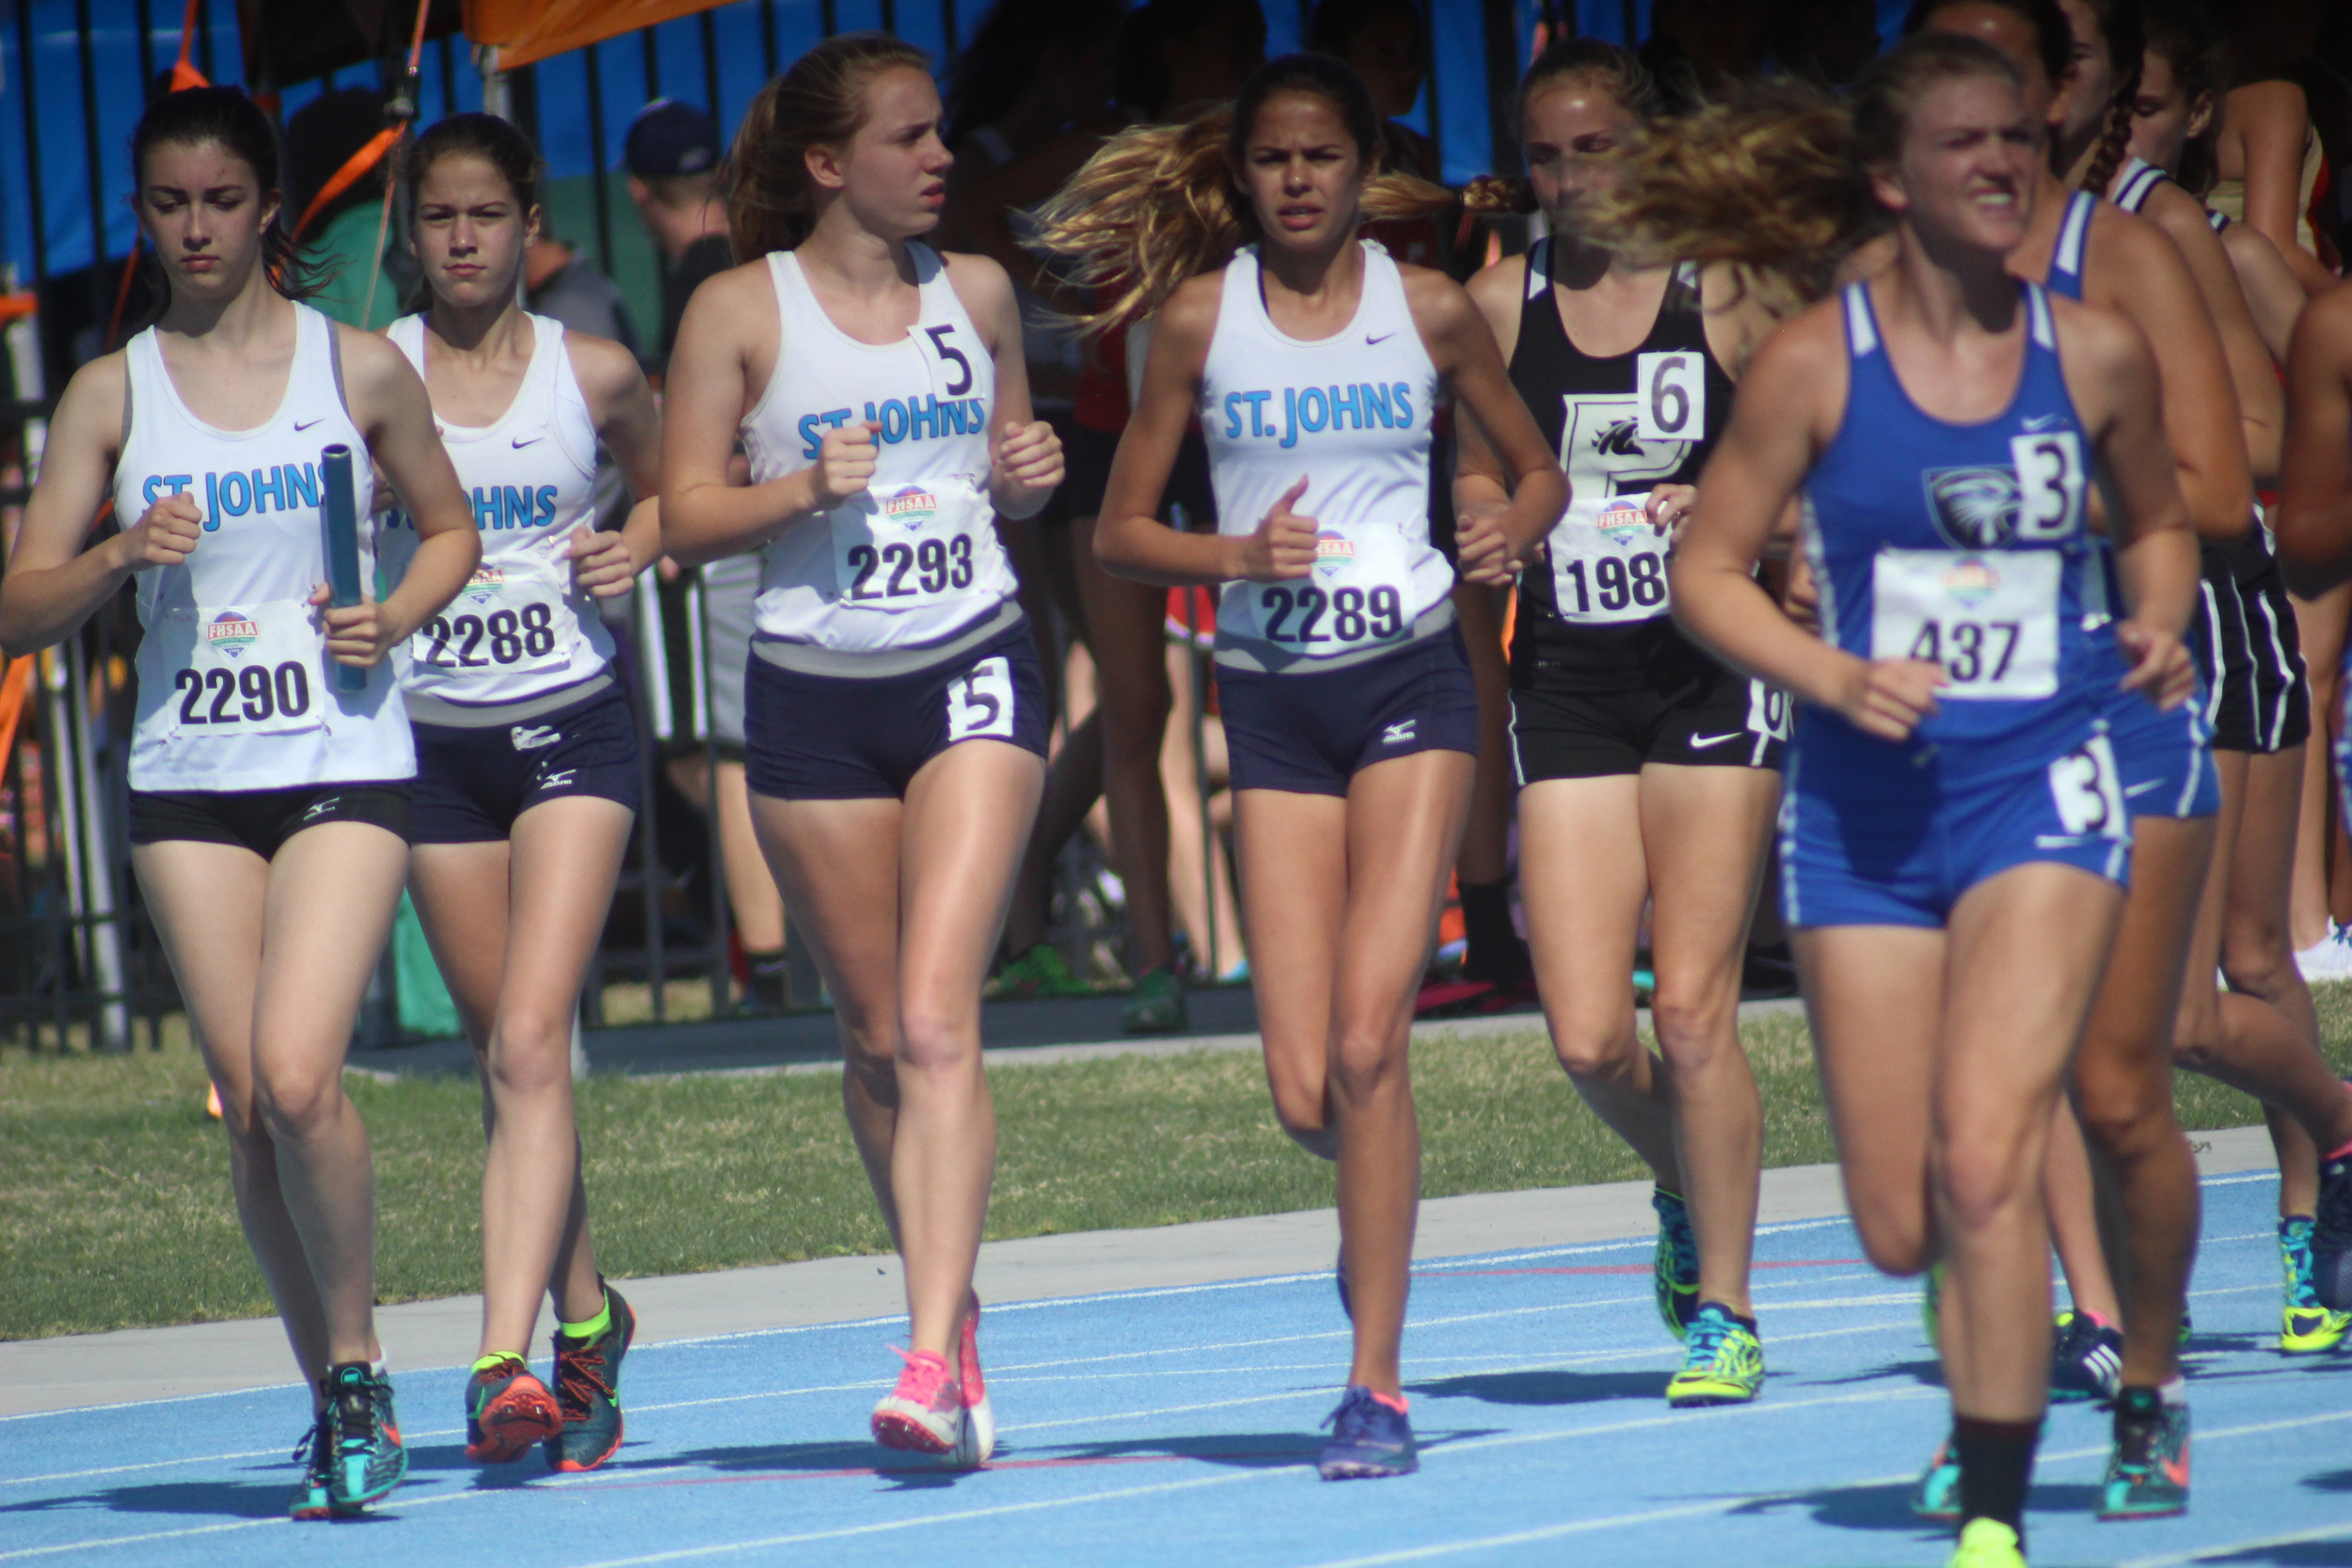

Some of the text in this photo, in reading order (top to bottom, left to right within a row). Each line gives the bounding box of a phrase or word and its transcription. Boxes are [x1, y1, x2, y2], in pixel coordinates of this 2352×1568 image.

[925, 323, 974, 396] 5
[1651, 356, 1690, 434] 6
[202, 462, 326, 532] JOHN
[461, 485, 558, 530] HNS
[887, 496, 936, 515] FHSAA
[2034, 443, 2068, 530] 3
[848, 533, 974, 601] 2293
[1565, 551, 1670, 613] 198
[208, 621, 257, 640] FHSAA
[420, 603, 555, 668] 2288
[1262, 585, 1403, 643] 2289
[1909, 620, 2021, 682] 437
[175, 660, 310, 725] 2290
[963, 664, 1001, 732] 5
[2069, 748, 2109, 832] 3
